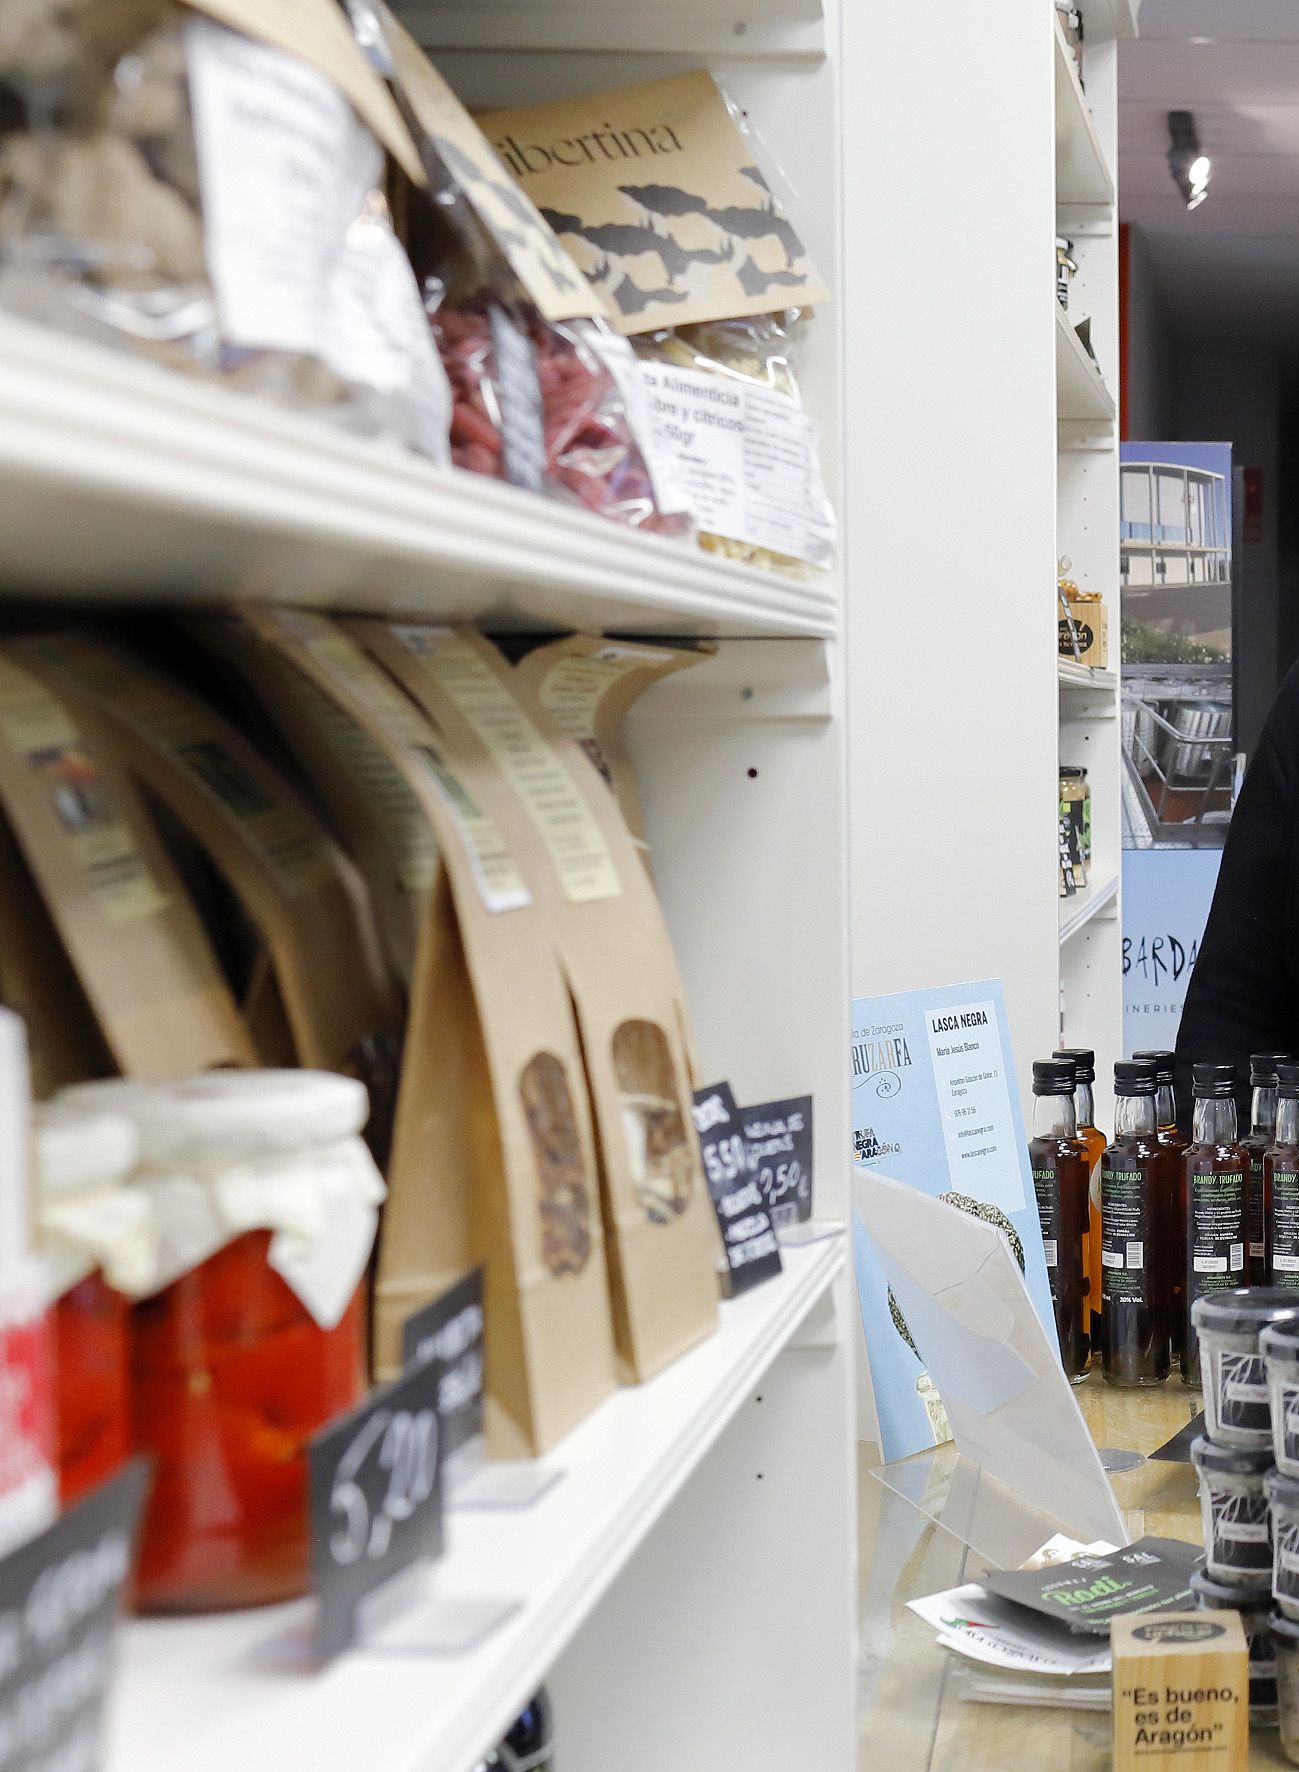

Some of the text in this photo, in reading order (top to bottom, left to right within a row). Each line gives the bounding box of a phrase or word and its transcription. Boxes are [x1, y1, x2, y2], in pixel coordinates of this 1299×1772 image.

[499, 122, 684, 178] ibertina
[1122, 934, 1201, 987] BARDA
[870, 1022, 904, 1036] Zaragoza
[931, 1010, 988, 1034] LASCA NEGRA
[852, 1037, 913, 1076] RUZARFA
[963, 1042, 980, 1053] Blanco
[1032, 1170, 1055, 1181] UFADO
[1115, 1171, 1142, 1181] TRUFADO
[1193, 1173, 1243, 1185] BRANDY TRUFADO
[1273, 1172, 1297, 1184] BRANDY
[1122, 1685, 1240, 1707] “Es bueno,
[1134, 1706, 1193, 1726] es de
[1134, 1722, 1223, 1749] Aragón”
